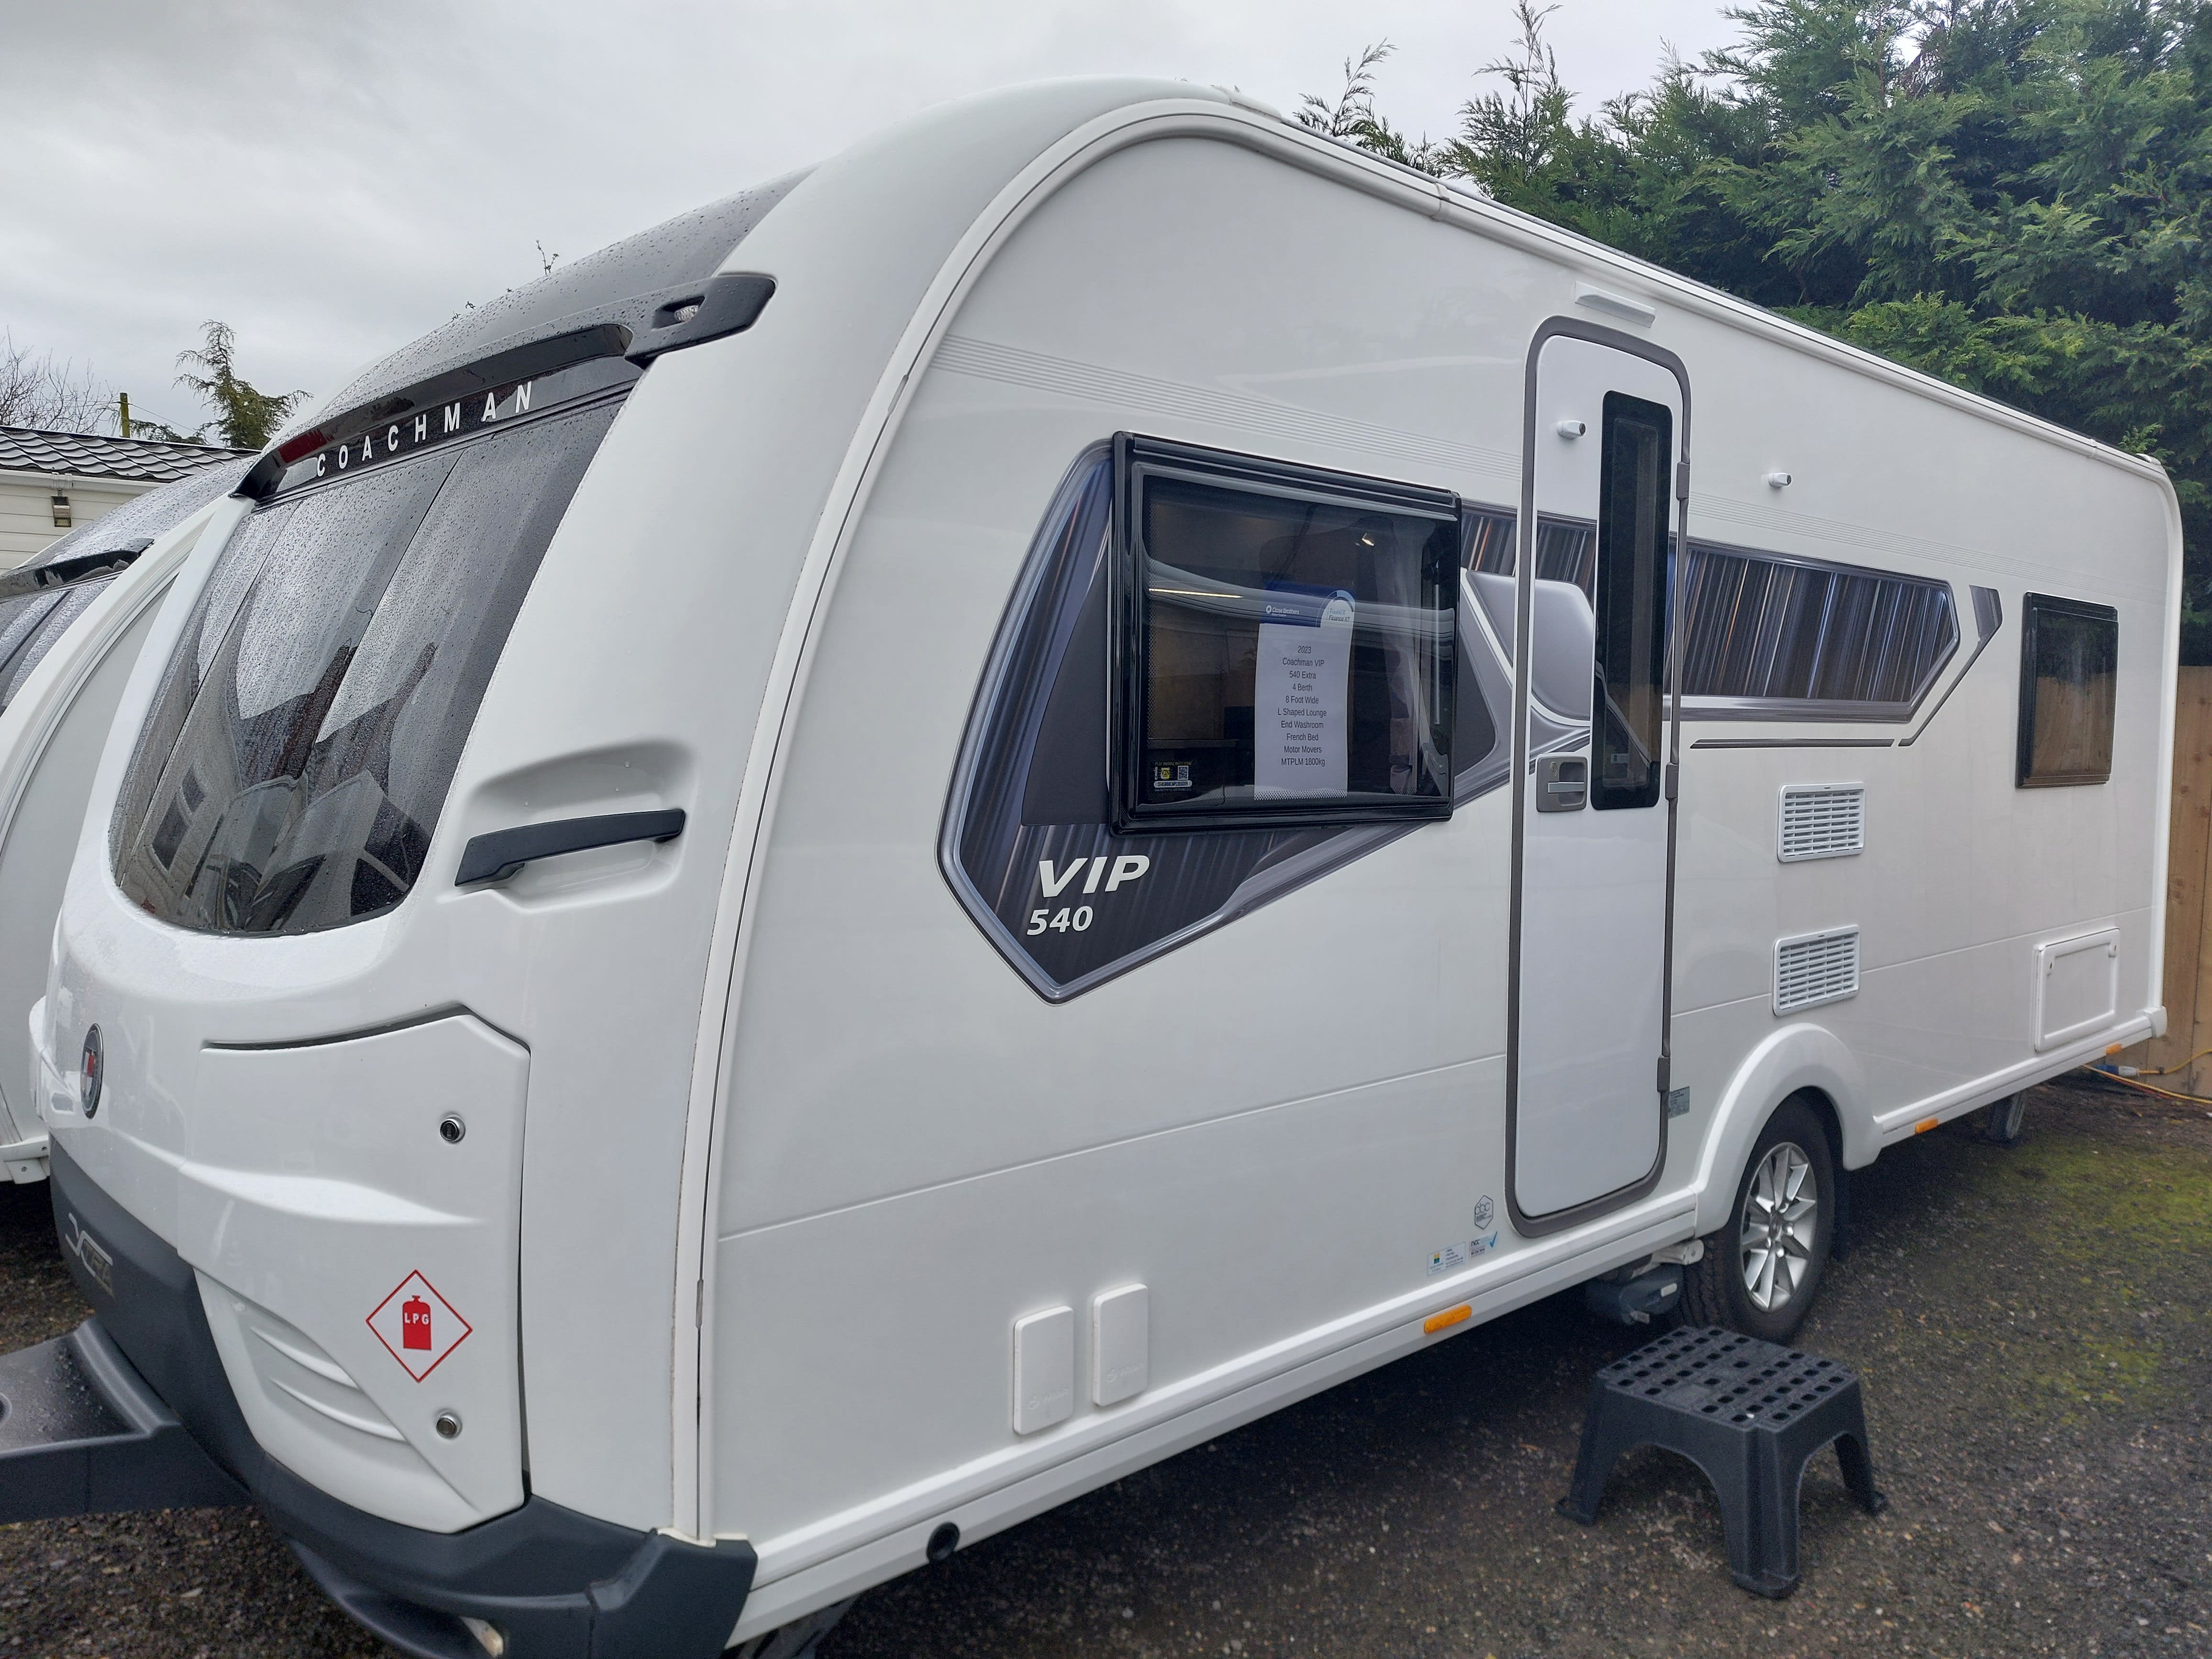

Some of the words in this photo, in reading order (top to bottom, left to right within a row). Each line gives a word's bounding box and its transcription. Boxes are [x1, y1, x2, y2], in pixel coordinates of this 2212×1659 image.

[316, 381, 532, 477] COACHMAN
[1283, 657, 1313, 666] Coachman
[1289, 670, 1300, 678] 540
[1302, 671, 1316, 679] Extra
[1297, 683, 1313, 691] Berth
[1291, 696, 1304, 704] Foot
[1305, 696, 1319, 704] Wide
[1278, 708, 1281, 716] L
[1283, 708, 1305, 718] Shaped
[1306, 708, 1327, 718] Lounge
[1294, 720, 1324, 729] Washroom
[1307, 733, 1319, 741] Bed
[1302, 745, 1322, 753] Movers
[1281, 758, 1303, 766] MTPLM
[1305, 758, 1325, 767] 1800kg
[1039, 855, 1150, 898] VIP
[1026, 905, 1094, 936] 540
[404, 1312, 430, 1325] LPG
